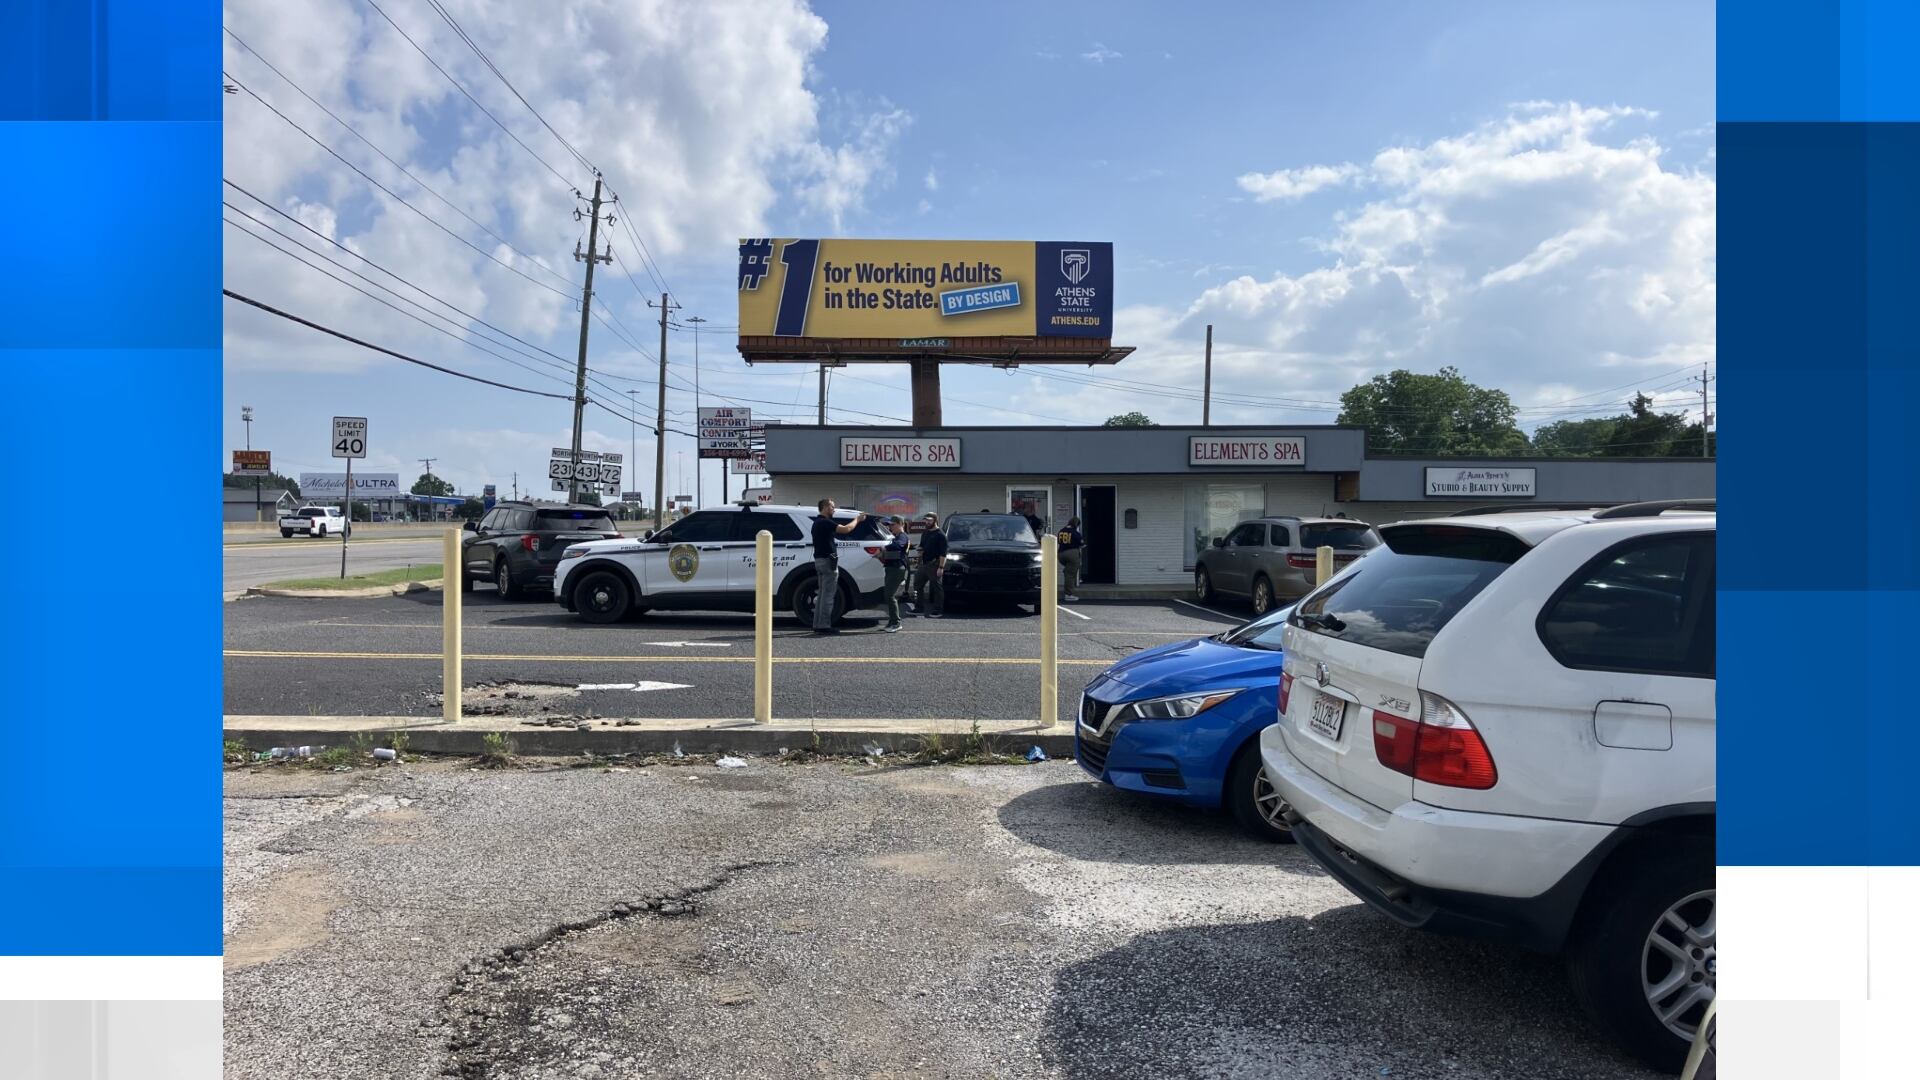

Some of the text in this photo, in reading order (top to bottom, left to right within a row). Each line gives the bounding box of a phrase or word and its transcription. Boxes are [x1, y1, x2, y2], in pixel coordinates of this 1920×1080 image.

[824, 261, 851, 284] for
[856, 262, 935, 288] Working
[940, 262, 1001, 283] Adults
[1055, 287, 1096, 297] ATHENS
[824, 288, 939, 309] in the State.
[948, 289, 1010, 310] BY DESIGN
[1061, 297, 1090, 306] STATE
[1051, 316, 1100, 326] ATHENS.EDU
[903, 339, 945, 347] LAMAR
[715, 409, 734, 418] AIR
[336, 421, 365, 429] SPEED
[701, 418, 748, 426] COMFORT
[335, 438, 364, 454] 40
[1194, 443, 1301, 460] ELEMENTS SPA
[845, 444, 956, 462] ELEMENTS SPA
[552, 464, 572, 475] 231
[577, 467, 597, 478] 431
[604, 469, 620, 480] 72
[1462, 483, 1468, 492] &
[1059, 531, 1072, 544] FBI
